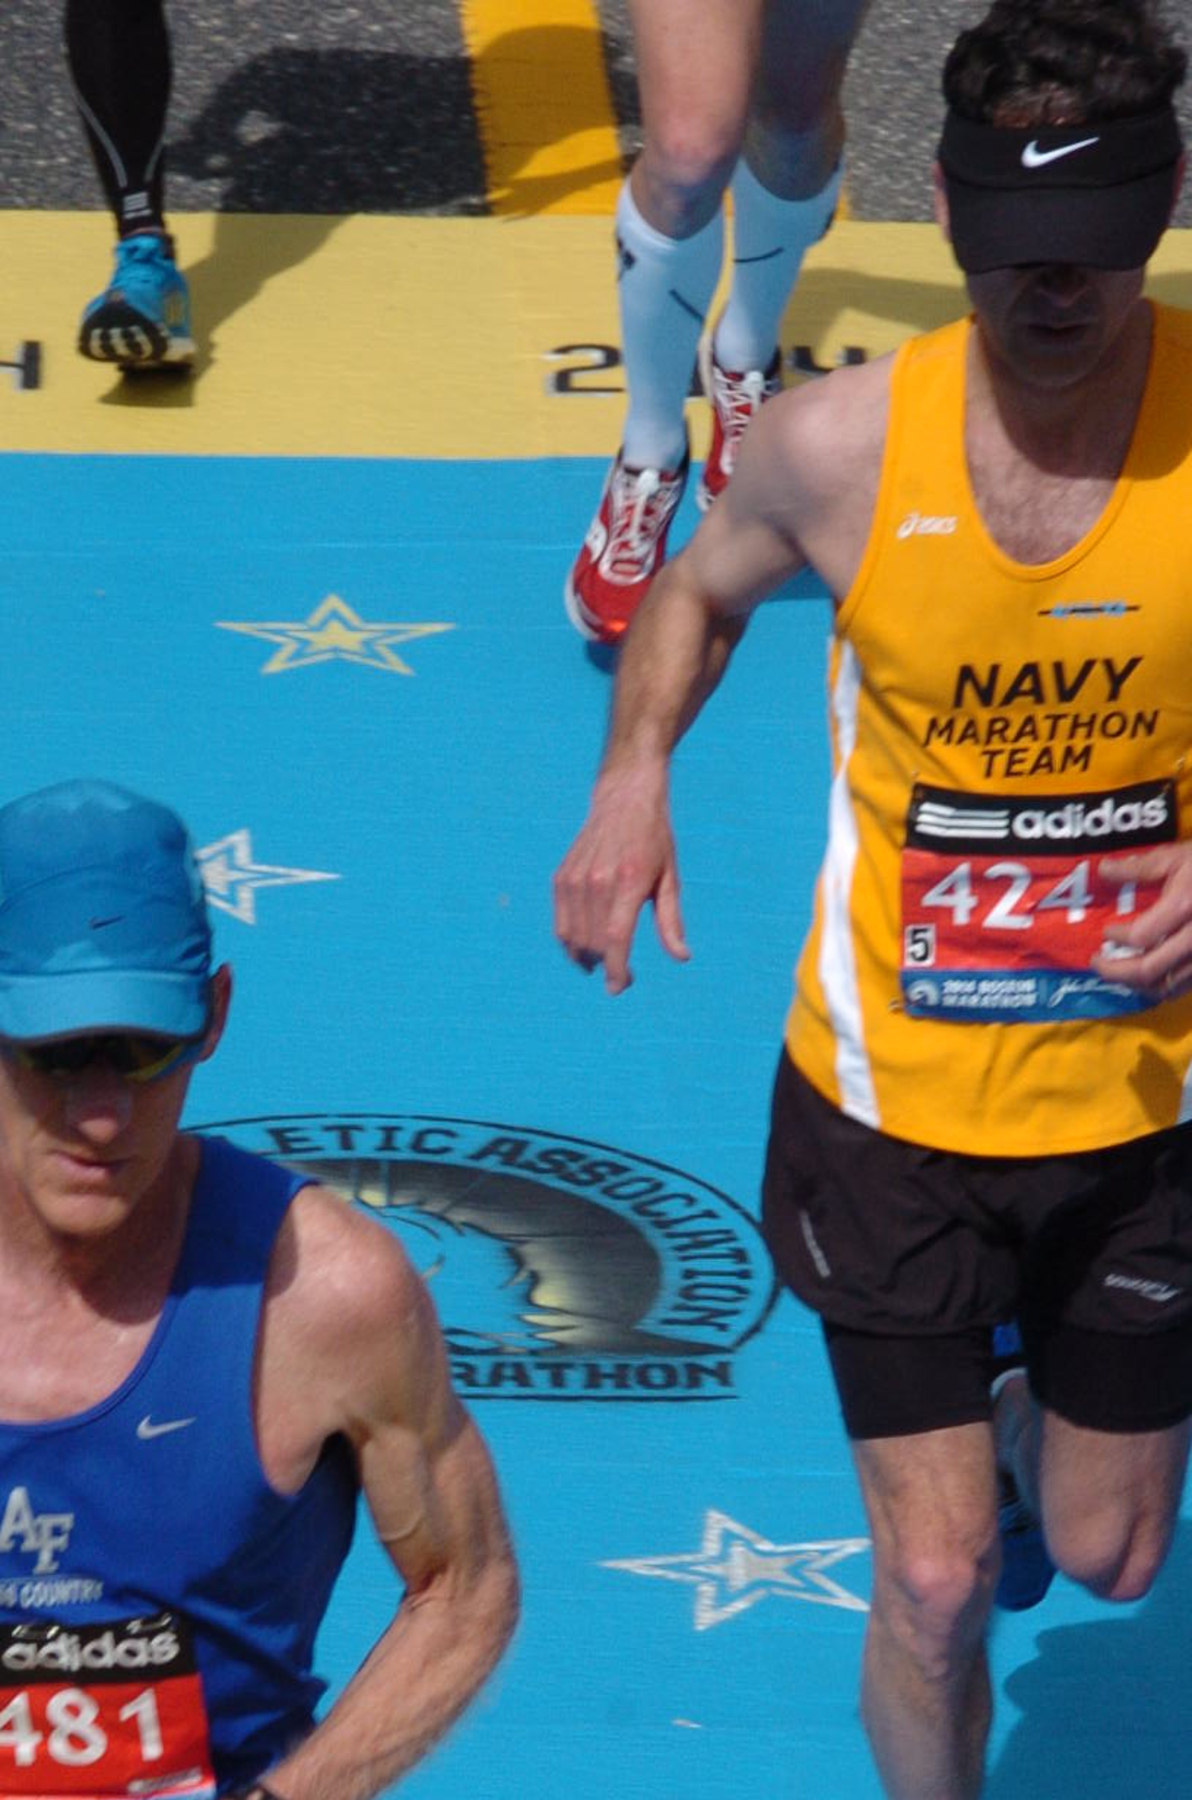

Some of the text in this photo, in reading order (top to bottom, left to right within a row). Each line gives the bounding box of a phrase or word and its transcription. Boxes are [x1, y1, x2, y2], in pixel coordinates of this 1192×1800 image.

[953, 655, 1145, 709] NAVY
[923, 709, 1160, 748] MARATHON
[981, 744, 1094, 778] TEAM
[1012, 797, 1168, 839] adidas
[908, 928, 930, 961] 5
[264, 1125, 460, 1156] ETIC
[466, 1137, 752, 1332] ASSOCIATION
[452, 1361, 735, 1389] RATHON
[1, 1632, 180, 1672] adidas
